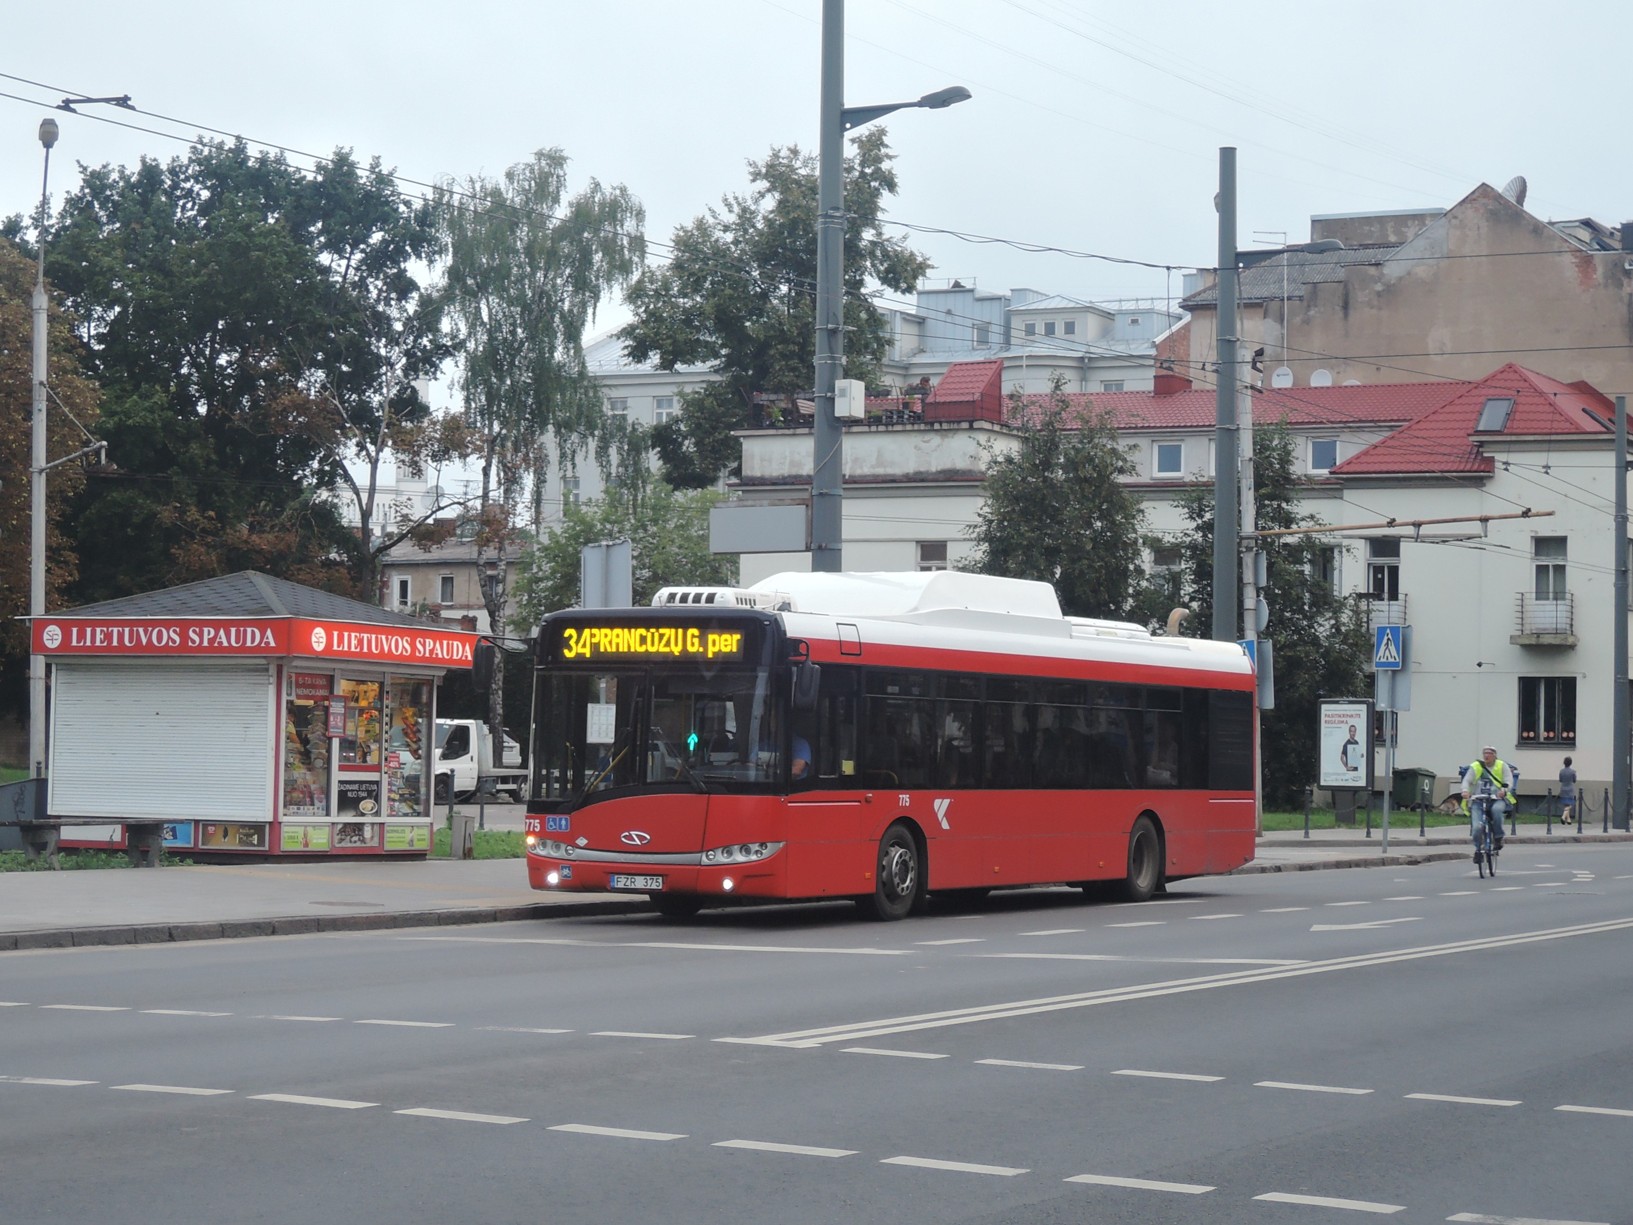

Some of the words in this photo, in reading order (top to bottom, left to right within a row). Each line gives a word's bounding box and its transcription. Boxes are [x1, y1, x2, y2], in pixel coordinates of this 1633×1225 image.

[71, 627, 180, 647] LIETUVOS
[188, 627, 276, 647] SPAUDA
[563, 628, 590, 658] 34
[687, 628, 704, 652] G.
[708, 633, 741, 658] per
[332, 630, 411, 656] LIETUVOS
[415, 637, 473, 661] SPAUDA
[898, 794, 910, 807] 775
[525, 819, 541, 832] 775
[616, 876, 637, 887] FZR
[643, 877, 661, 888] 375
